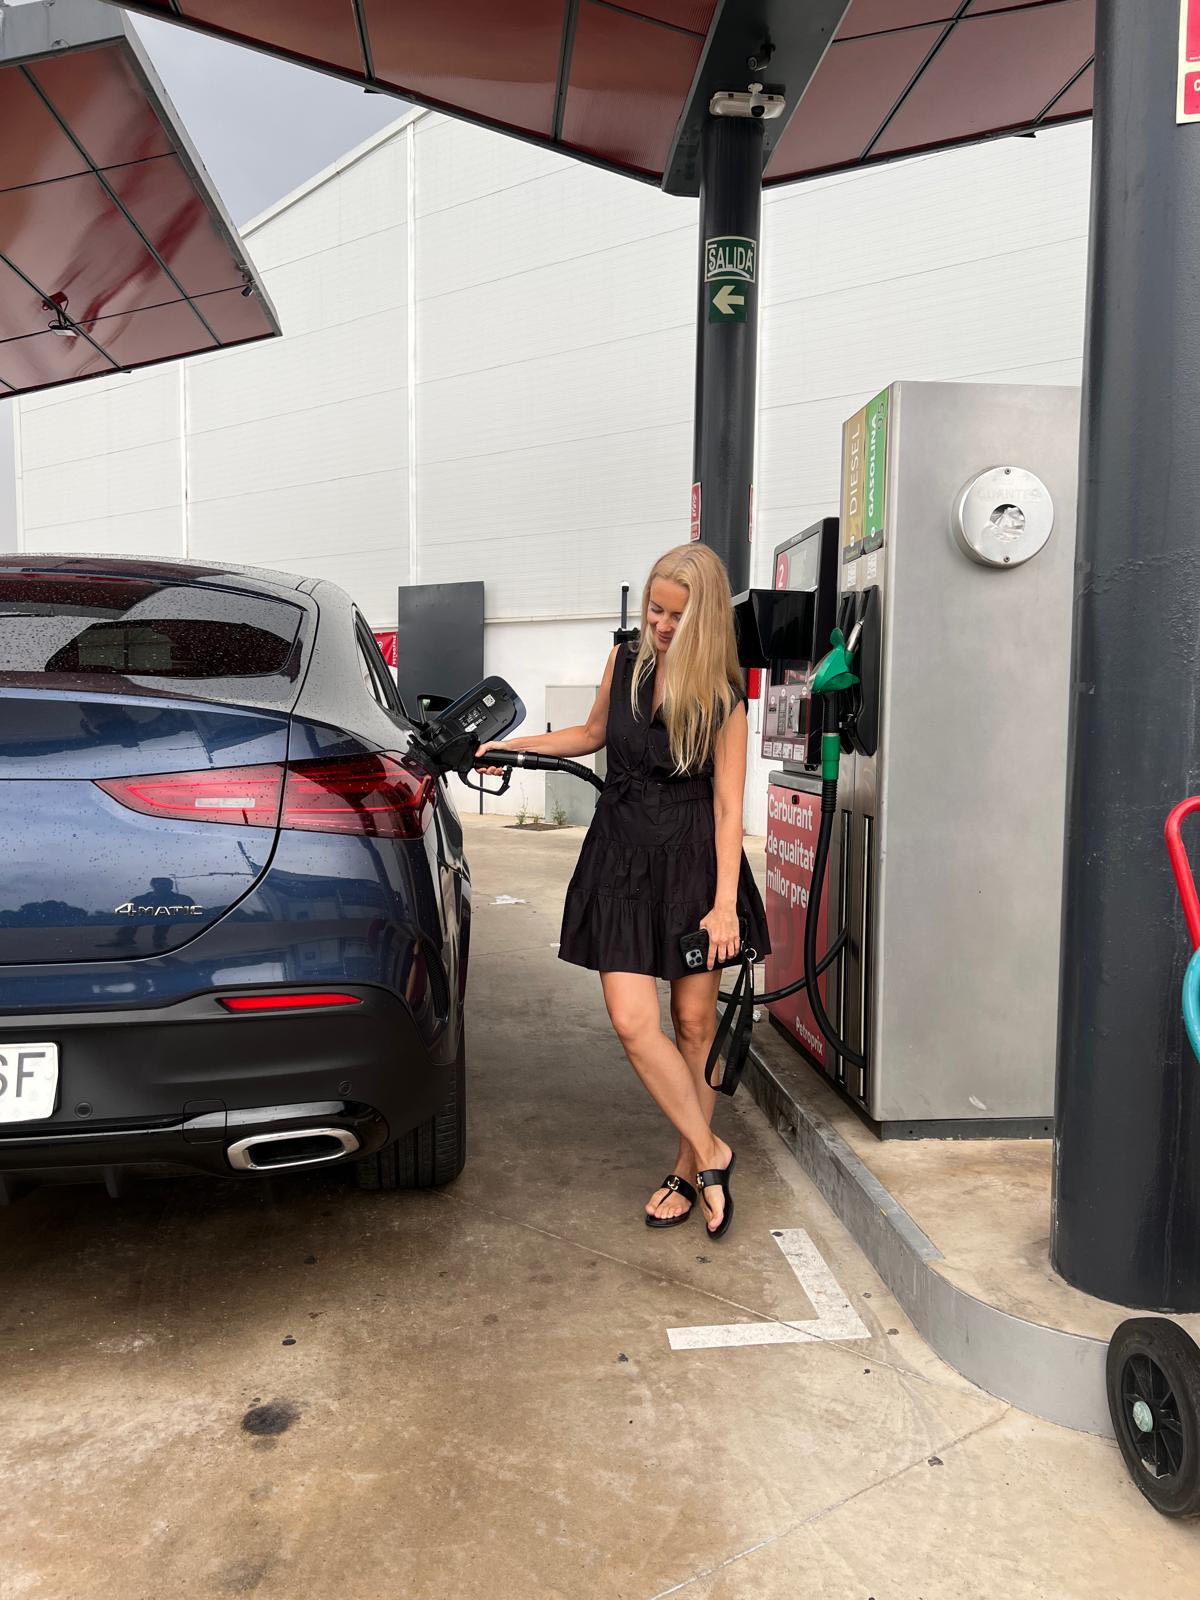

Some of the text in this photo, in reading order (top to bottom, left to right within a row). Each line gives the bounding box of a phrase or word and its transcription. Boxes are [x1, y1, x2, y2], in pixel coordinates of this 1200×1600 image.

[708, 246, 753, 272] SALIDA
[850, 423, 860, 516] DIESEL
[868, 402, 885, 518] GASOLINA 95
[778, 564, 784, 588] 2
[768, 793, 813, 832] Carburant
[767, 830, 814, 873] de qualitat
[767, 866, 789, 898] millor
[114, 902, 203, 917] 4MATIC
[796, 1015, 823, 1057] Petroprix
